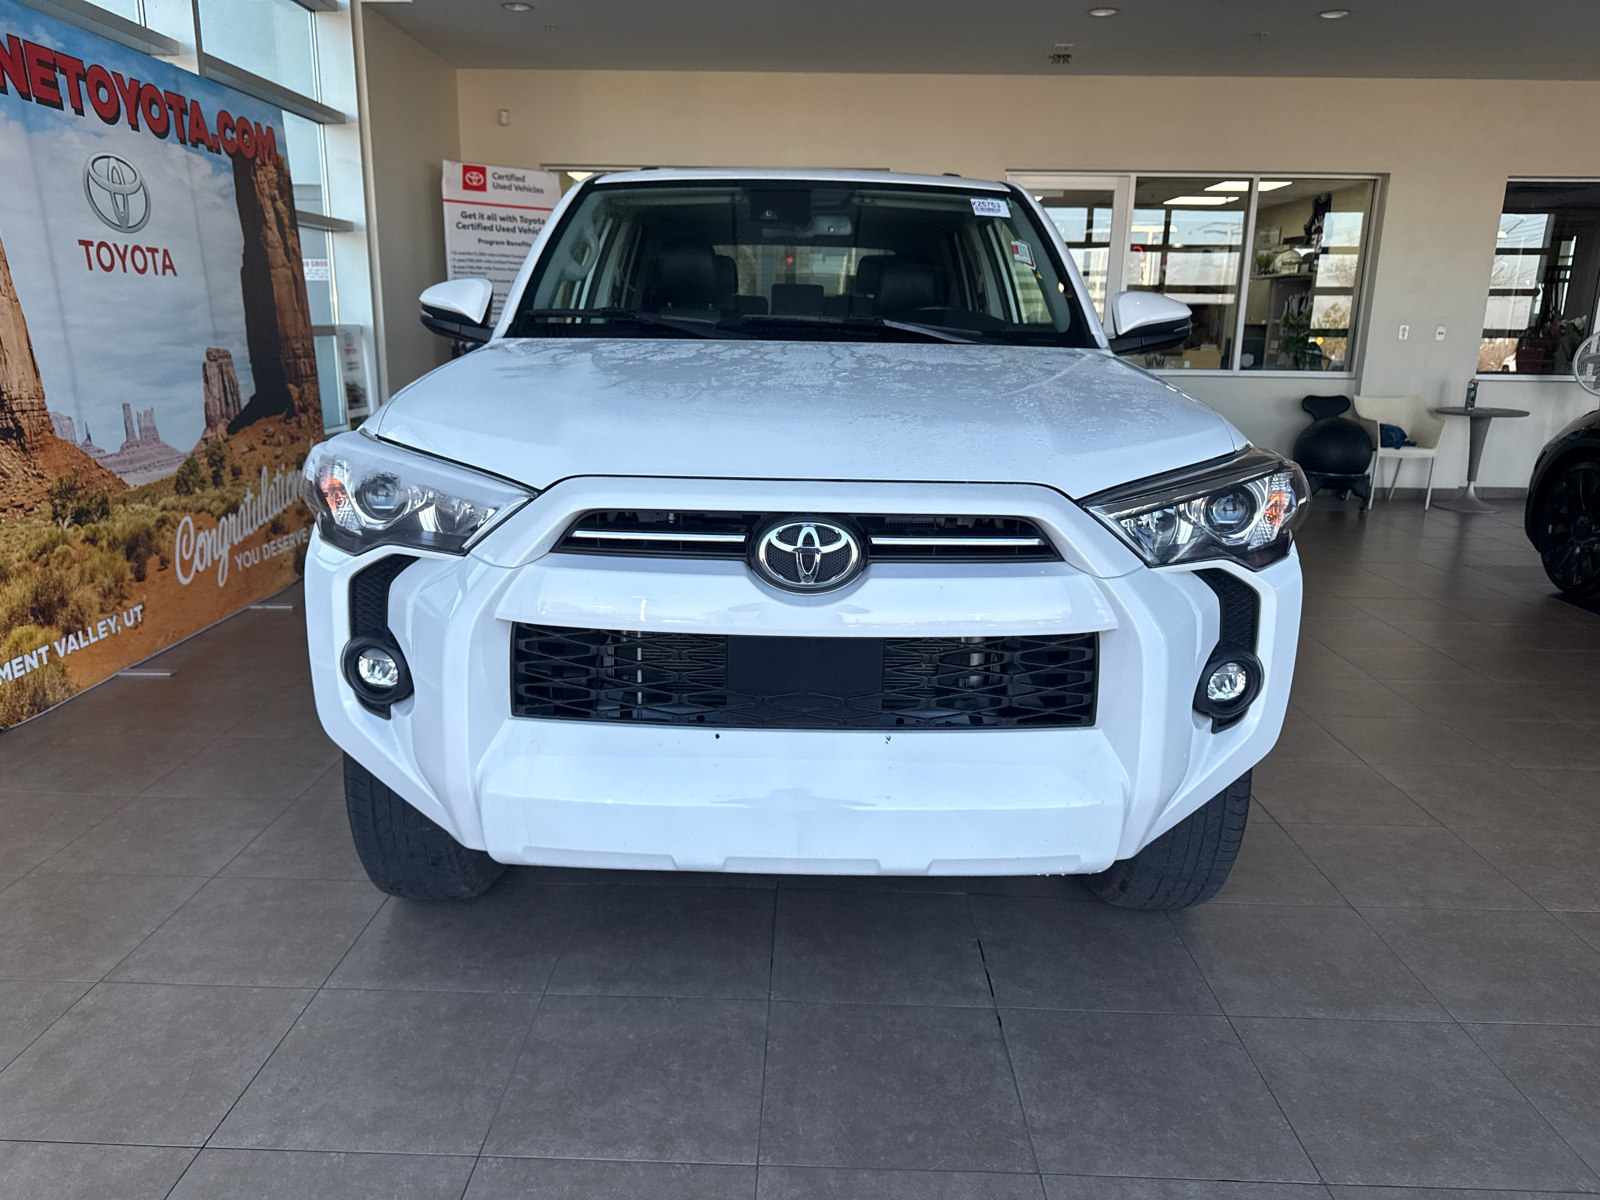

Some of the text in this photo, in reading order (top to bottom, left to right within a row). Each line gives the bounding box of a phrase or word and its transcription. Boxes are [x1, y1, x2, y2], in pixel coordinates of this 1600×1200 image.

[492, 172, 526, 182] Certified
[492, 182, 545, 194] Used Vehicles
[460, 211, 546, 226] Get it all with Toyota
[456, 222, 494, 232] Certified
[495, 223, 517, 234] Used
[477, 238, 532, 248] Program Benefits
[78, 239, 178, 277] TOYOTA
[234, 547, 260, 571] YOU
[262, 527, 309, 560] DESERVE
[0, 604, 144, 685] MENT VALLEY, UT
